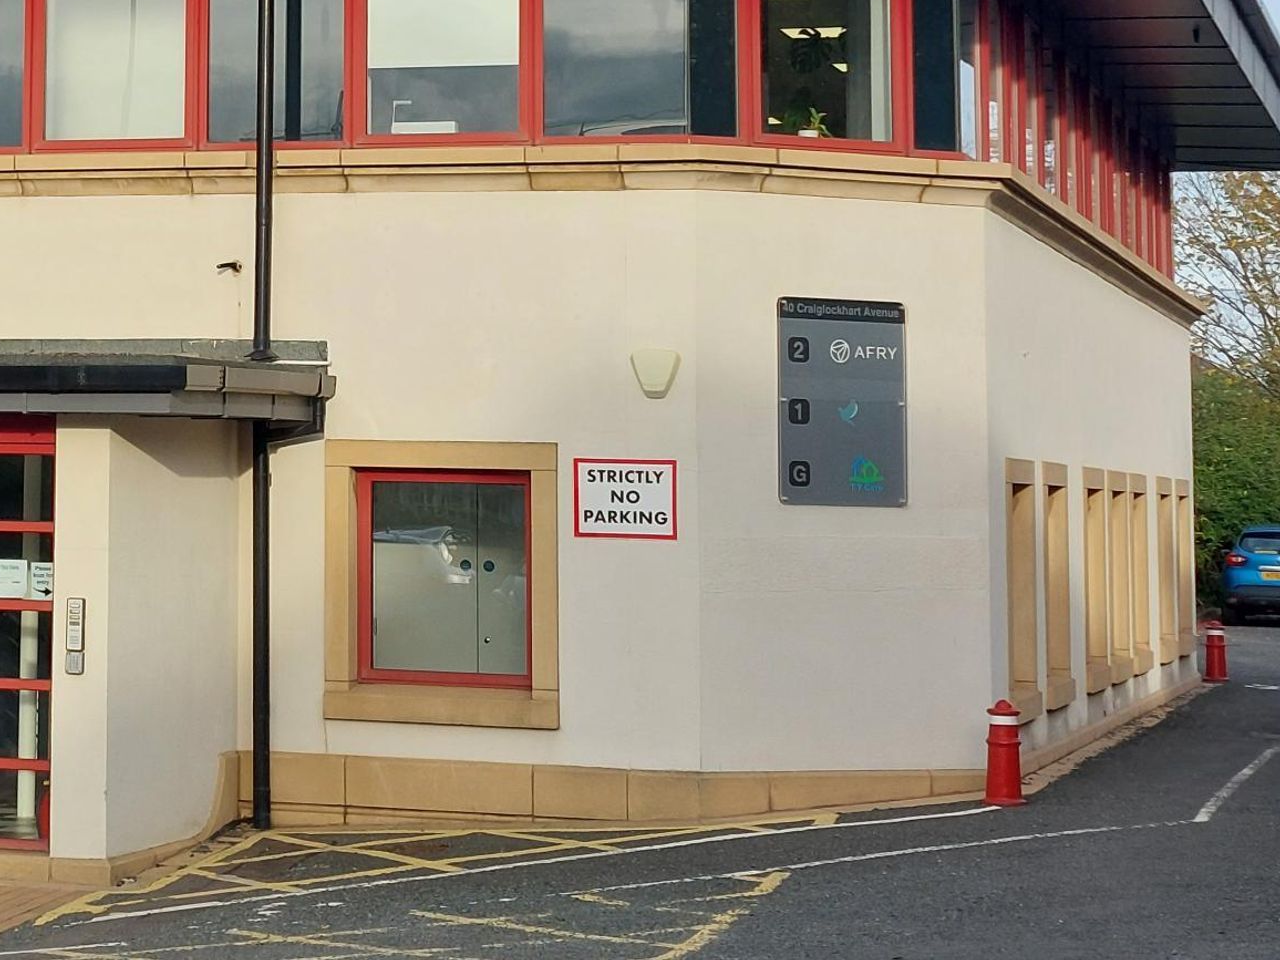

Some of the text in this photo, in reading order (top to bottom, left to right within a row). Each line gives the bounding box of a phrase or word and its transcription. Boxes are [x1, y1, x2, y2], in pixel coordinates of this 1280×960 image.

[863, 307, 900, 318] Avenue
[793, 342, 805, 359] 2
[854, 346, 898, 360] AFRY
[794, 403, 803, 421] 1
[587, 469, 664, 484] STRICTLY
[793, 465, 807, 483] G
[610, 490, 641, 504] NO
[583, 510, 669, 525] PARKING
